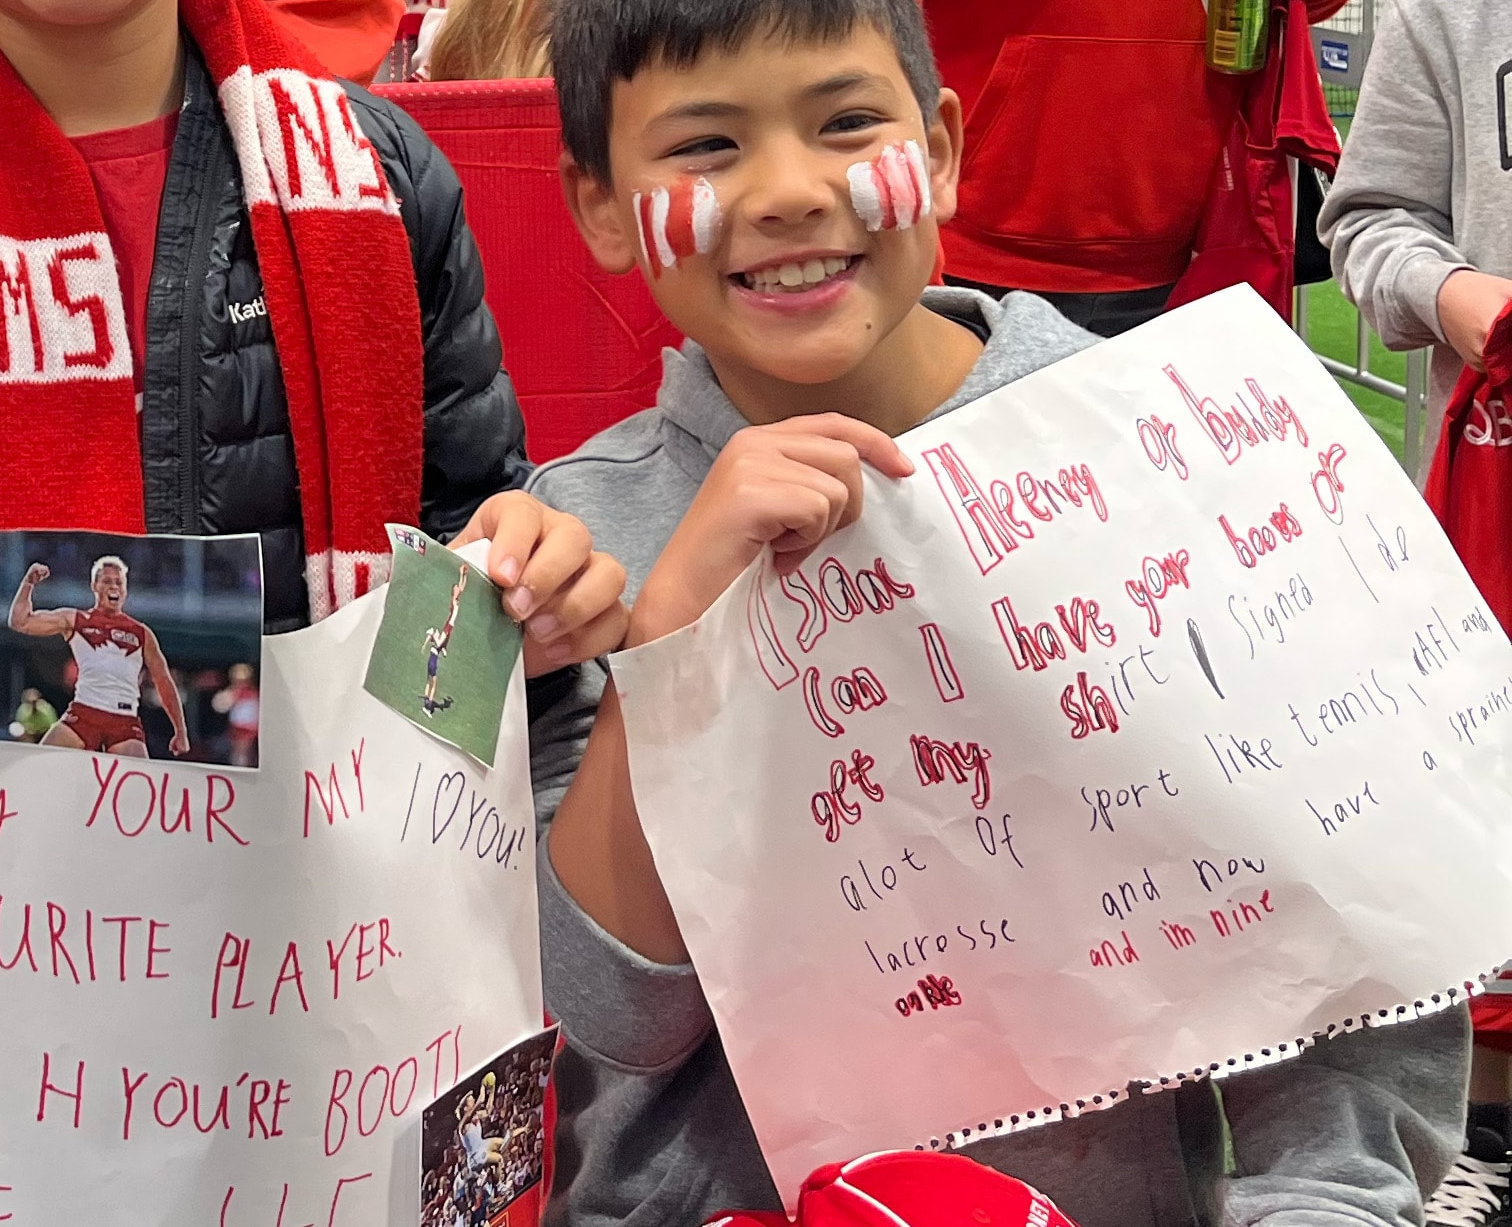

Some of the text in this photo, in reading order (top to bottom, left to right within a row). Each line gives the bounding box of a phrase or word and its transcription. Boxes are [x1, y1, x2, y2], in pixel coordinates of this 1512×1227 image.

[920, 442, 1108, 576] Heeney
[1136, 414, 1189, 482] or
[811, 748, 885, 843] get
[1060, 644, 1171, 740] shirt
[1338, 535, 1381, 604] I
[918, 622, 965, 704] I
[991, 596, 1117, 673] have
[85, 756, 251, 846] YOUR
[303, 736, 365, 839] MY
[840, 847, 927, 912] alot
[1080, 768, 1179, 833] sport
[1204, 733, 1284, 784] like
[1461, 605, 1493, 634] and
[864, 918, 1016, 974] lacrosse
[1101, 866, 1162, 921] and
[1192, 856, 1266, 893] now
[1305, 781, 1382, 836] have
[1422, 750, 1438, 771] a
[209, 916, 403, 1020] PLAYER.
[1089, 930, 1140, 968] and
[1159, 920, 1197, 951] im
[1209, 889, 1275, 938] nine
[36, 1051, 85, 1129] H
